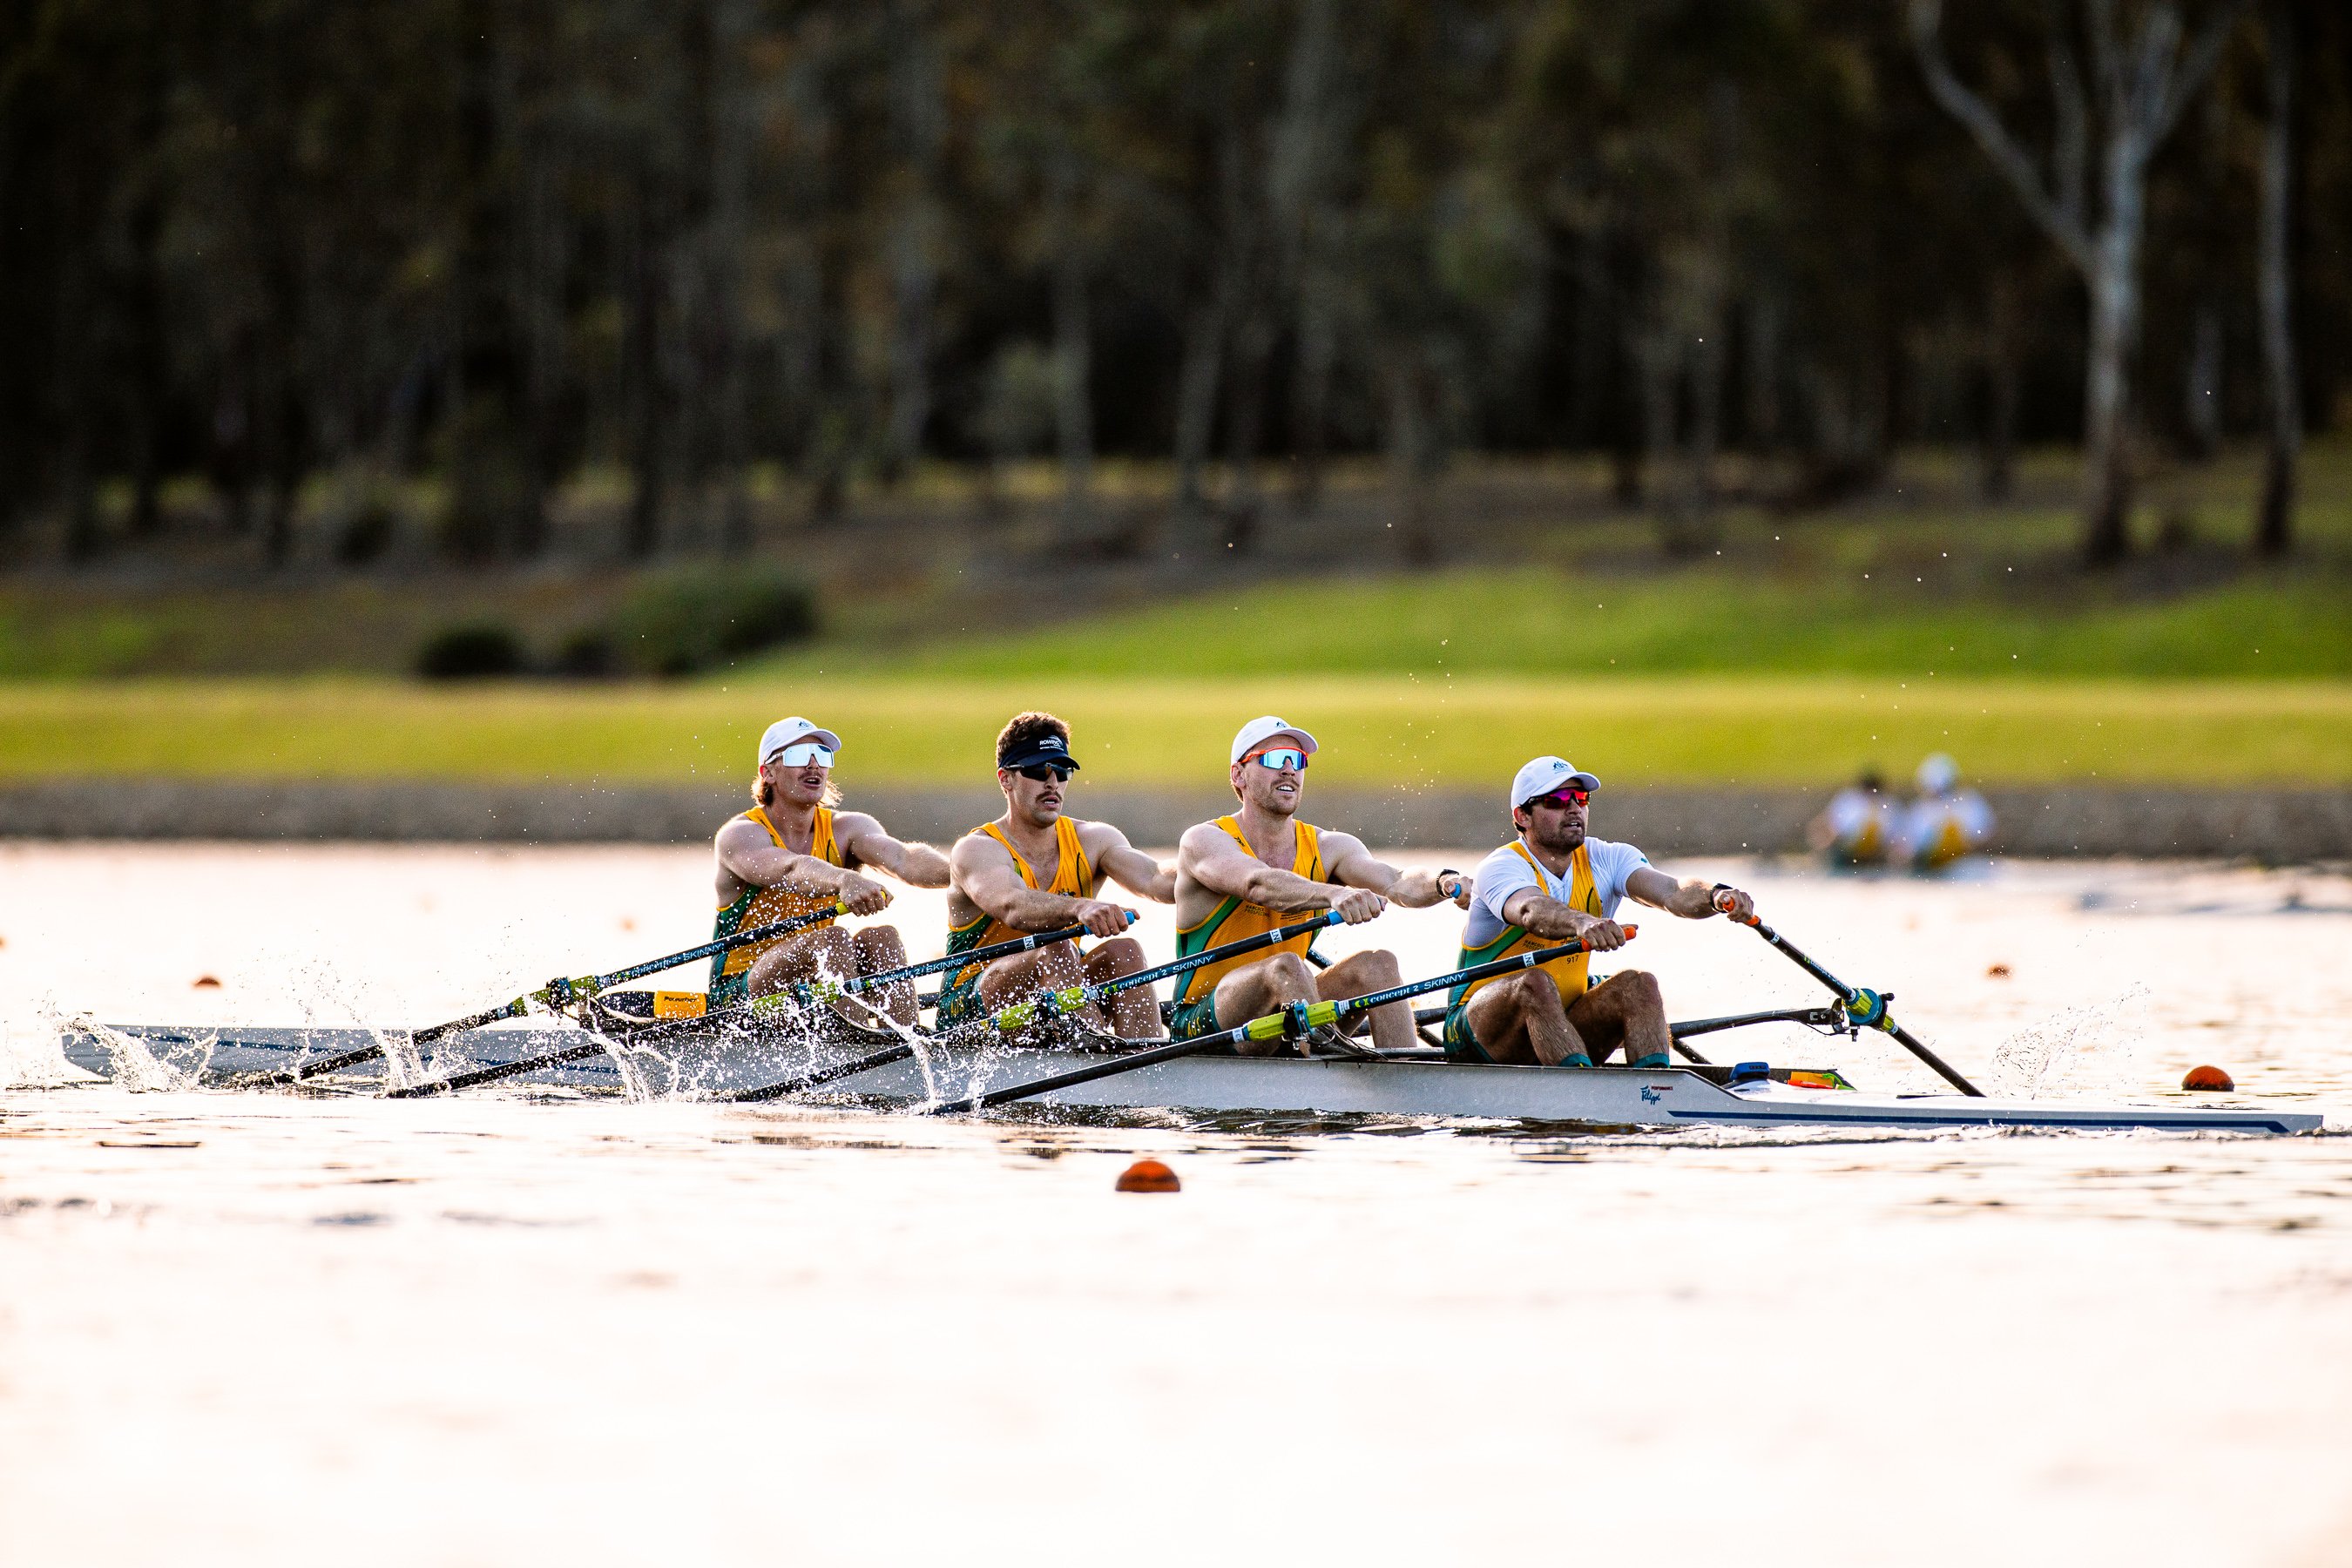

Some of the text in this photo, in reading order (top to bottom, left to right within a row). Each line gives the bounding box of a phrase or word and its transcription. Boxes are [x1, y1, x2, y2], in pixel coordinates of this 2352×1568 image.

[683, 942, 723, 961] SKINNY
[1566, 955, 1579, 964] 917
[926, 956, 966, 973] SKINNY
[1119, 972, 1159, 990] concept
[1173, 955, 1213, 974] SKINNY
[1370, 988, 1410, 1004] concept
[1423, 972, 1465, 990] SKINNY
[1187, 1017, 1202, 1038] AUS
